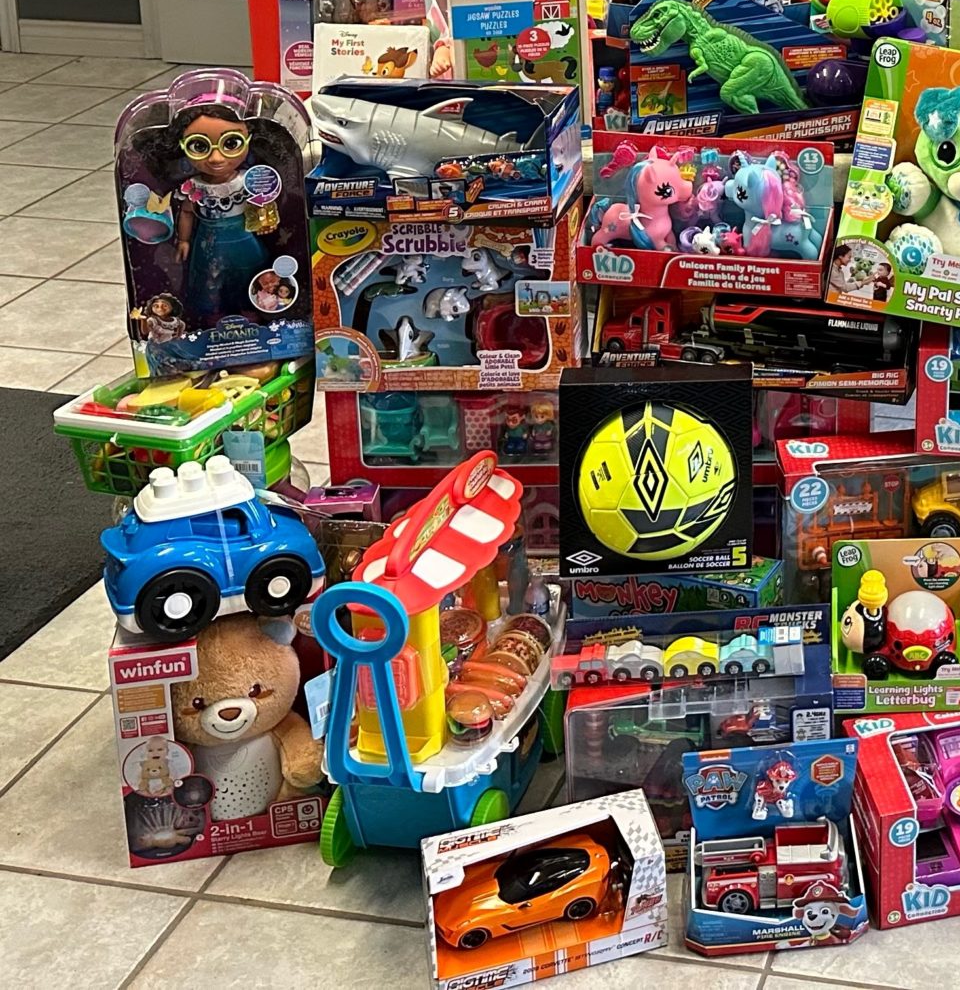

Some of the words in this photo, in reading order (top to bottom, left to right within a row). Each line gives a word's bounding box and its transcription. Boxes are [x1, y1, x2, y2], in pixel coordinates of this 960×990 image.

[467, 12, 490, 22] JIGSAW
[492, 10, 519, 19] PUZZLES
[481, 21, 507, 30] PUZZLES
[530, 30, 538, 41] 3
[332, 39, 343, 47] My
[879, 47, 897, 56] Leap
[879, 55, 897, 65] Frog
[644, 115, 718, 134] ADVENTURE
[785, 119, 828, 131] ROARING
[831, 115, 851, 124] REX
[794, 123, 851, 138] RUGISSANT
[804, 153, 818, 163] 13
[314, 180, 376, 194] ADVENTURE
[325, 226, 367, 242] Crayola
[392, 224, 442, 235] SCRIBBLE
[383, 234, 467, 254] Scrubbie
[596, 253, 633, 273] KID
[679, 261, 714, 271] Unicorn
[716, 262, 745, 273] Family
[747, 266, 780, 276] Playset
[694, 271, 734, 281] Ensemble
[736, 273, 749, 282] de
[750, 275, 765, 283] jeu
[688, 279, 719, 288] Famille
[721, 281, 733, 289] de
[735, 281, 771, 291] licornes
[903, 281, 926, 299] My
[929, 288, 951, 304] Pal
[906, 299, 953, 319] Smarty
[828, 319, 857, 329] FLAMMABLE
[858, 321, 878, 331] LIQUID
[930, 360, 948, 372] 19
[789, 443, 829, 456] KID
[800, 482, 822, 497] 22
[732, 546, 747, 566] 5
[839, 546, 858, 557] Leap
[841, 554, 859, 565] Frog
[569, 566, 599, 574] umbro
[119, 660, 187, 679] winfun
[869, 685, 910, 695] Learning
[914, 685, 943, 695] Lights
[876, 695, 935, 708] Letterbug
[856, 719, 894, 735] KID
[211, 820, 253, 836] 2-in-1
[896, 822, 913, 836] 19
[902, 888, 949, 912] KID
[752, 925, 805, 936] MARSHALL
